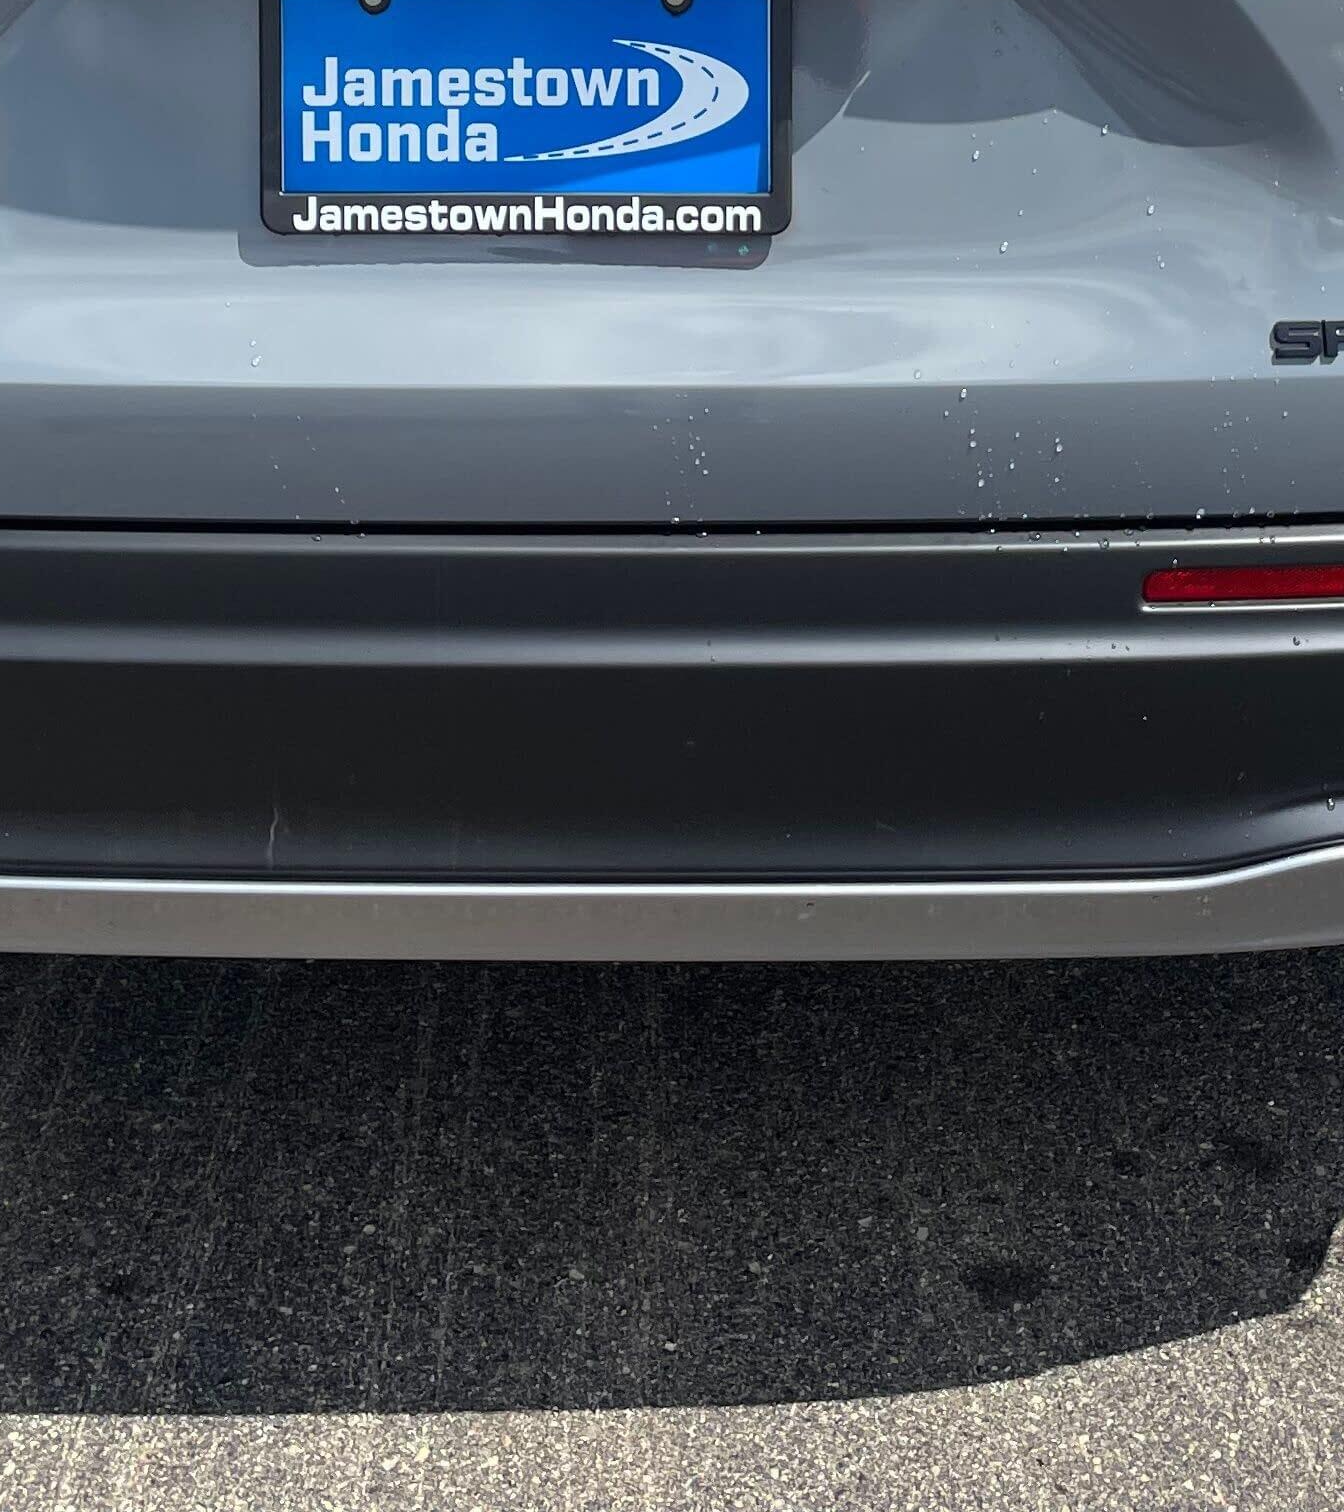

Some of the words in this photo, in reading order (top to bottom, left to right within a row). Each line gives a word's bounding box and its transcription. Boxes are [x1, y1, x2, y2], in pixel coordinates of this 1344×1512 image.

[302, 56, 661, 107] Jamestown
[301, 108, 499, 162] Honda
[292, 195, 762, 232] JamestownHonda.com
